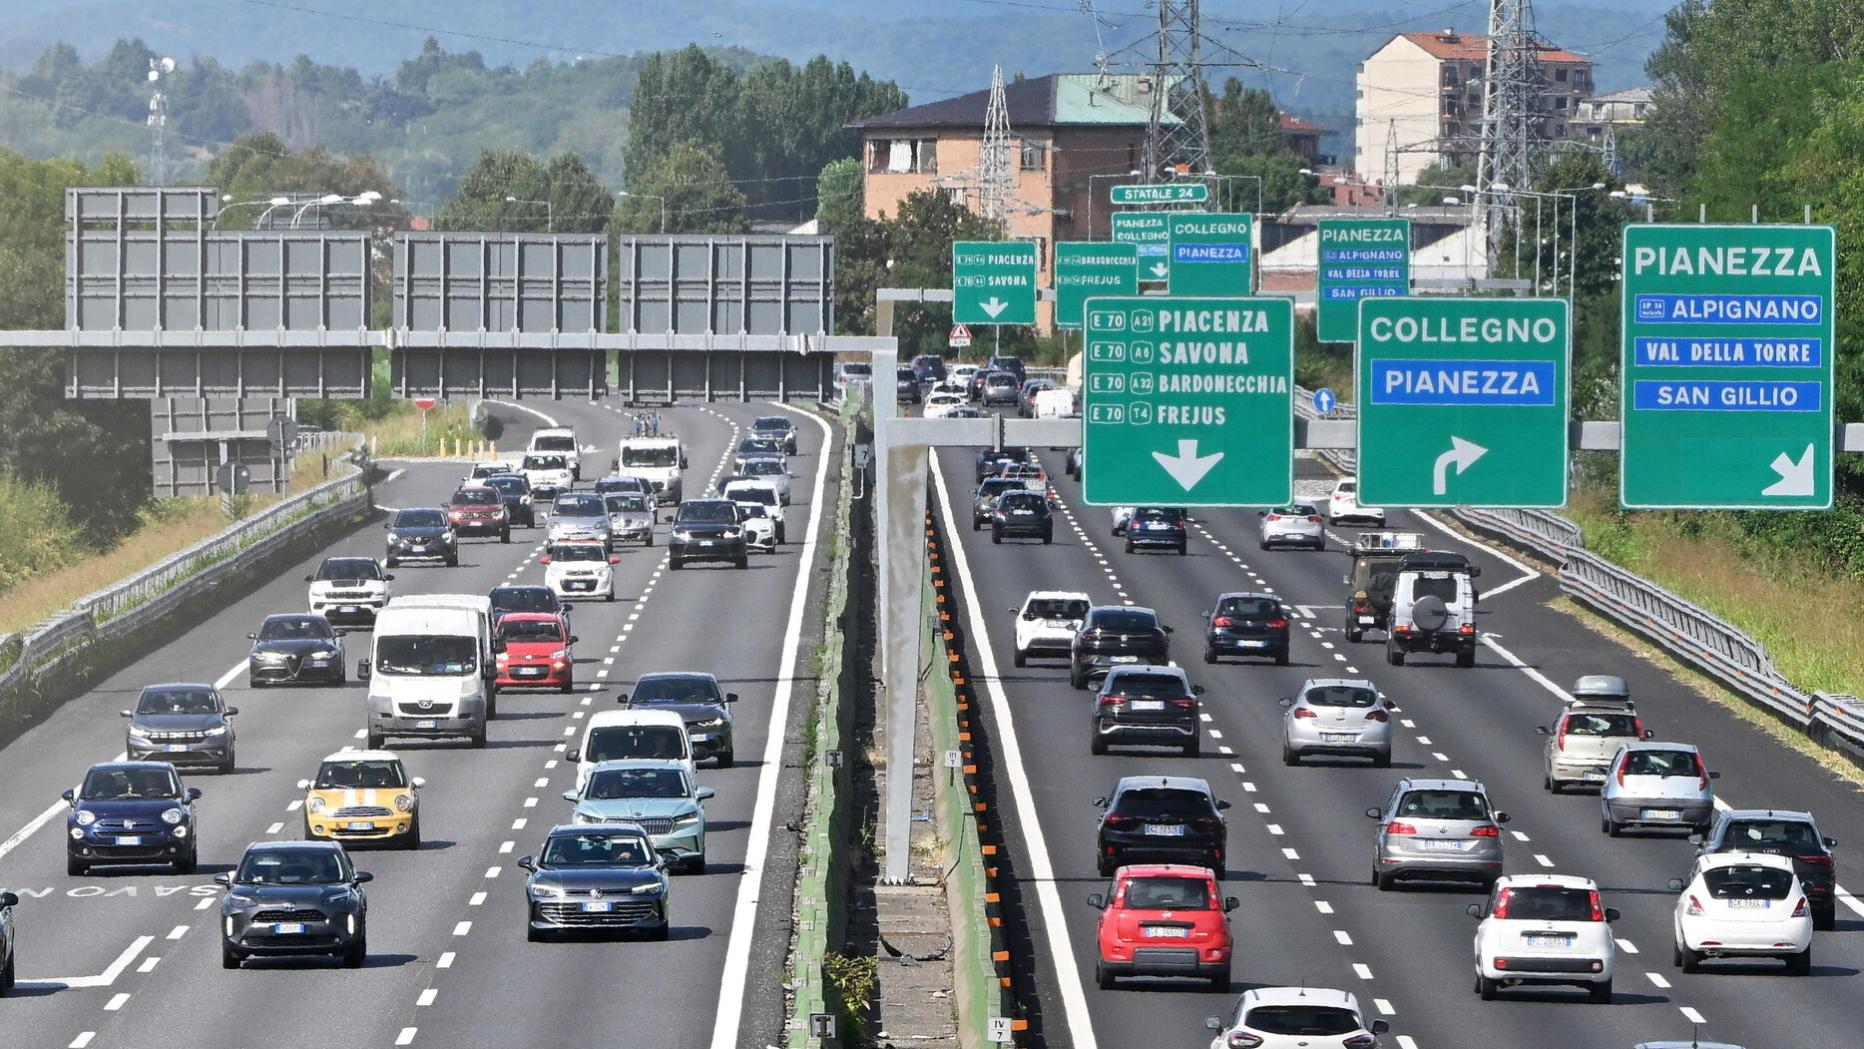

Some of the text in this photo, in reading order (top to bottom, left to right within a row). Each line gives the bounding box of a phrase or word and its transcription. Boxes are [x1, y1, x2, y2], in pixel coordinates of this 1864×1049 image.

[1124, 188, 1194, 199] STATALE 24
[1175, 223, 1247, 234] COLLEGNO
[1117, 231, 1168, 240] COLLEGNO
[1323, 229, 1403, 242] PIANEZZA
[1179, 248, 1242, 259] PIANEZZA
[1339, 250, 1403, 260] ALPIGNANO
[988, 255, 1034, 265] PIACENZA
[1635, 247, 1821, 276] PIANEZZA
[988, 275, 1027, 286] SAVONA
[1081, 275, 1121, 285] FREJUS
[1328, 270, 1343, 279] VAL
[1332, 289, 1355, 297] SAN
[1672, 300, 1817, 319] ALPIGNANO
[1093, 315, 1101, 328] E
[1108, 315, 1123, 328] 70
[1159, 310, 1268, 332] PIACENZA
[1371, 317, 1556, 343] COLLEGNO
[1093, 346, 1101, 358] E
[1107, 345, 1123, 358] 70
[1160, 342, 1248, 364] SAVONA
[1647, 343, 1809, 362] VAL DELLA TORRE
[1093, 375, 1286, 393] E 70 A32 BARDONECCHIA
[1386, 370, 1539, 394] PIANEZZA
[1658, 386, 1797, 405] SAN GILLIO
[1092, 408, 1100, 420] E
[1106, 408, 1122, 420] 70
[1158, 406, 1225, 424] FREJUS
[0, 885, 223, 898] SAVON
[994, 1020, 1004, 1028] IV
[997, 1031, 1003, 1040] 7
